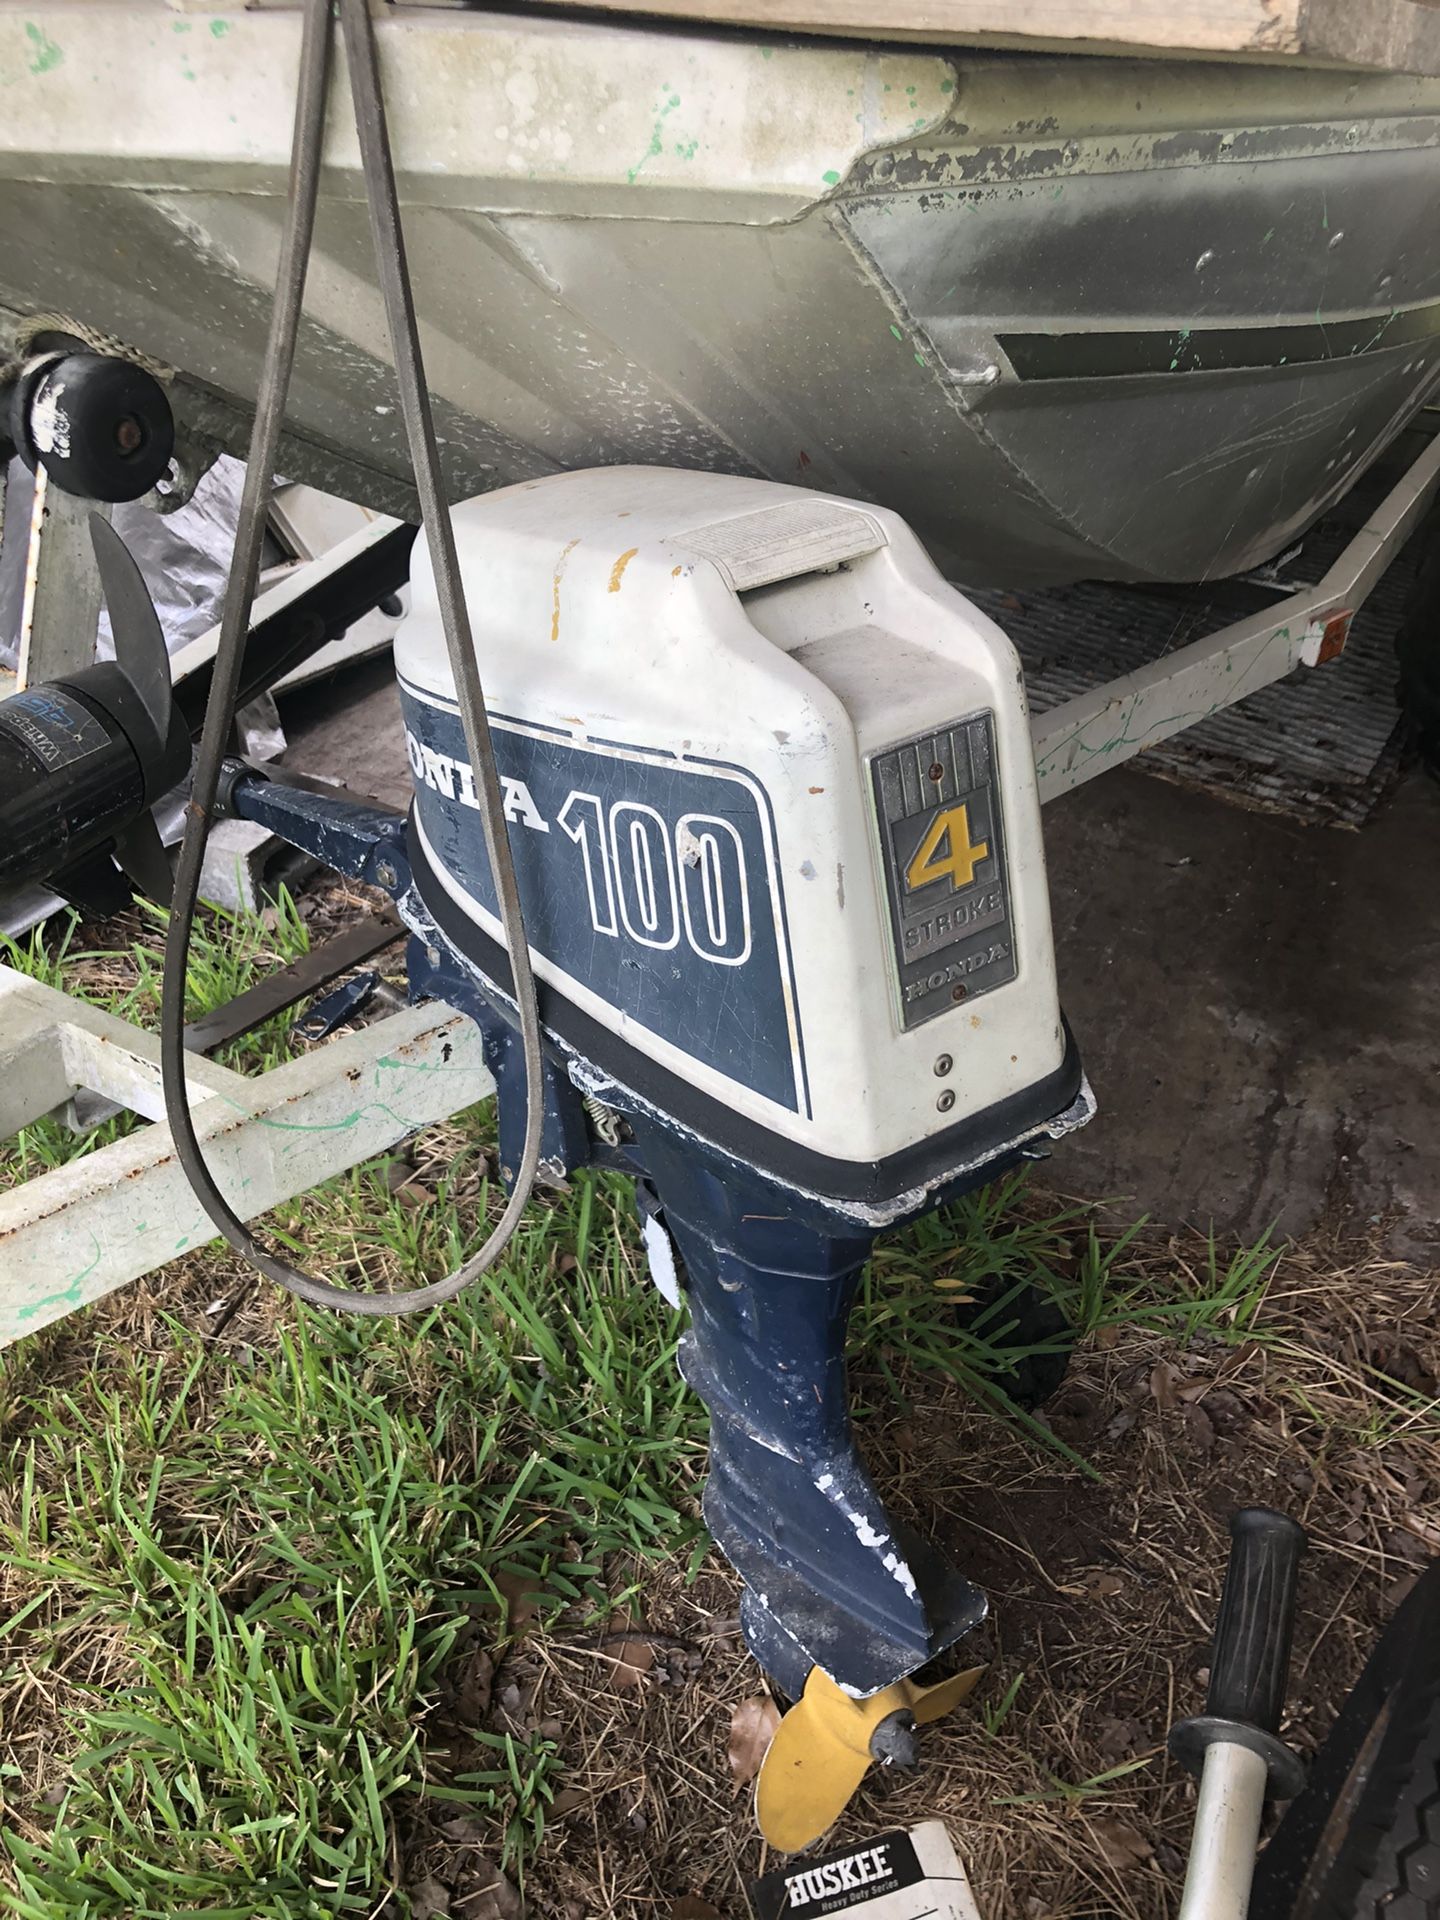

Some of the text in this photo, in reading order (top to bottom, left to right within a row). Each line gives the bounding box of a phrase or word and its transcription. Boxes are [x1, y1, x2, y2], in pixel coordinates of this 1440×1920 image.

[0, 711, 60, 762] Whispe
[403, 720, 751, 966] ONA 100
[905, 803, 989, 892] 4
[905, 890, 1002, 949] STROKE
[905, 943, 1010, 1002] HONDA
[785, 1844, 893, 1908] HUSKEE
[821, 1879, 899, 1912] Heavy Duty Series
